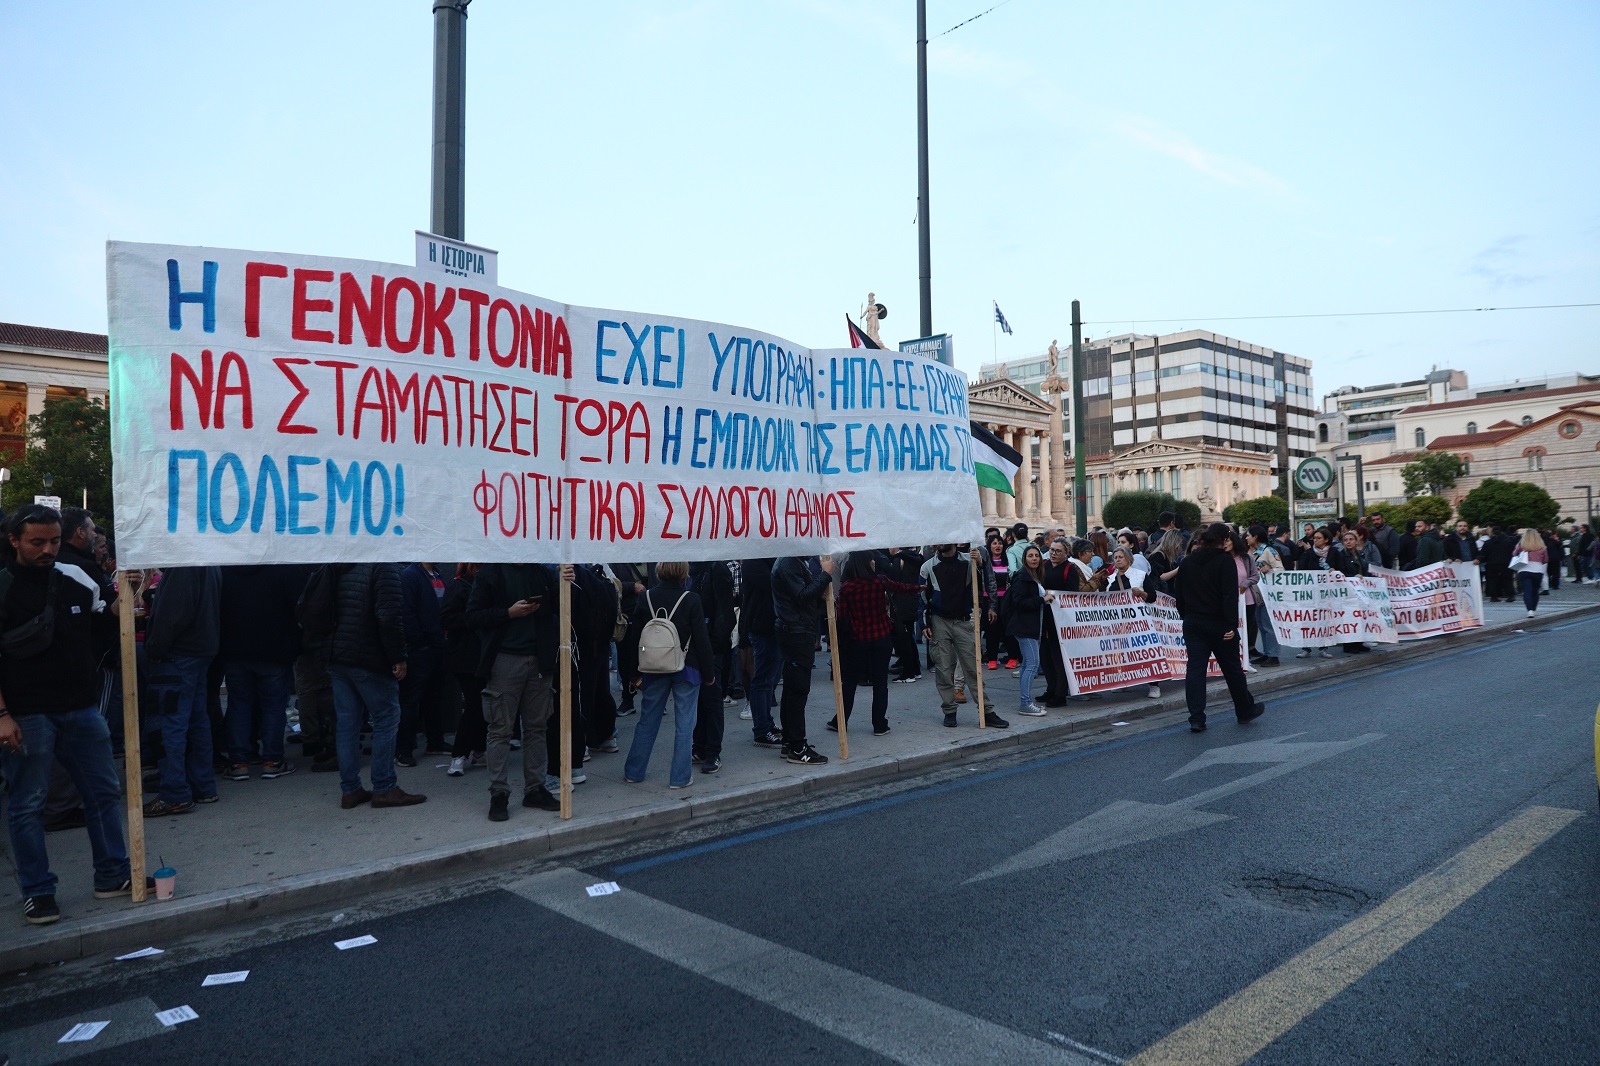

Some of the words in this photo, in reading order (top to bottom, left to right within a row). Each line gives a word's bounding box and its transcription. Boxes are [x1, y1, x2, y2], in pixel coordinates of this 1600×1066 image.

[429, 241, 437, 262] Η
[441, 245, 485, 275] ΙΣΤΟΡΙΑ
[167, 259, 218, 333] Η
[245, 262, 572, 379] ΓΕΝΟΚΤΟΝΙΑ
[596, 320, 685, 388] ΕΧΕΙ
[170, 350, 253, 431] ΝΑ
[273, 358, 539, 457] ΣΤΑΜΑΤΗΣΕΙ
[554, 393, 651, 464] ΤΩΡΑ
[661, 405, 682, 465] Η
[690, 408, 797, 473] ΕΜΠΛΟΚΗ
[801, 420, 840, 475] ΤΗΣ
[845, 421, 956, 472] ΕΛΛΑΔΑΣ
[167, 449, 405, 536] ΠΟΛΕΜΟ!
[473, 468, 645, 542] ΦΟΙΤΗΤΙΚΟΙ
[658, 484, 778, 539] ΣΥΛΛΟΓΟΙ
[784, 488, 866, 537] ΑΘΗΝΑΣ
[1272, 573, 1314, 585] ΙΣΤΟΡΙΑ
[1268, 591, 1284, 602] ΜΕ
[1292, 590, 1313, 601] ΤΗΝ
[1075, 609, 1120, 622] ΑΠΕΜΠΛΟΚΗ
[1121, 607, 1137, 619] ΑΠΟ
[1100, 640, 1112, 651] ΟΧΙ
[1113, 637, 1130, 650] ΣΤΗΝ
[1105, 651, 1126, 667] ΣΤΟΥΣ
